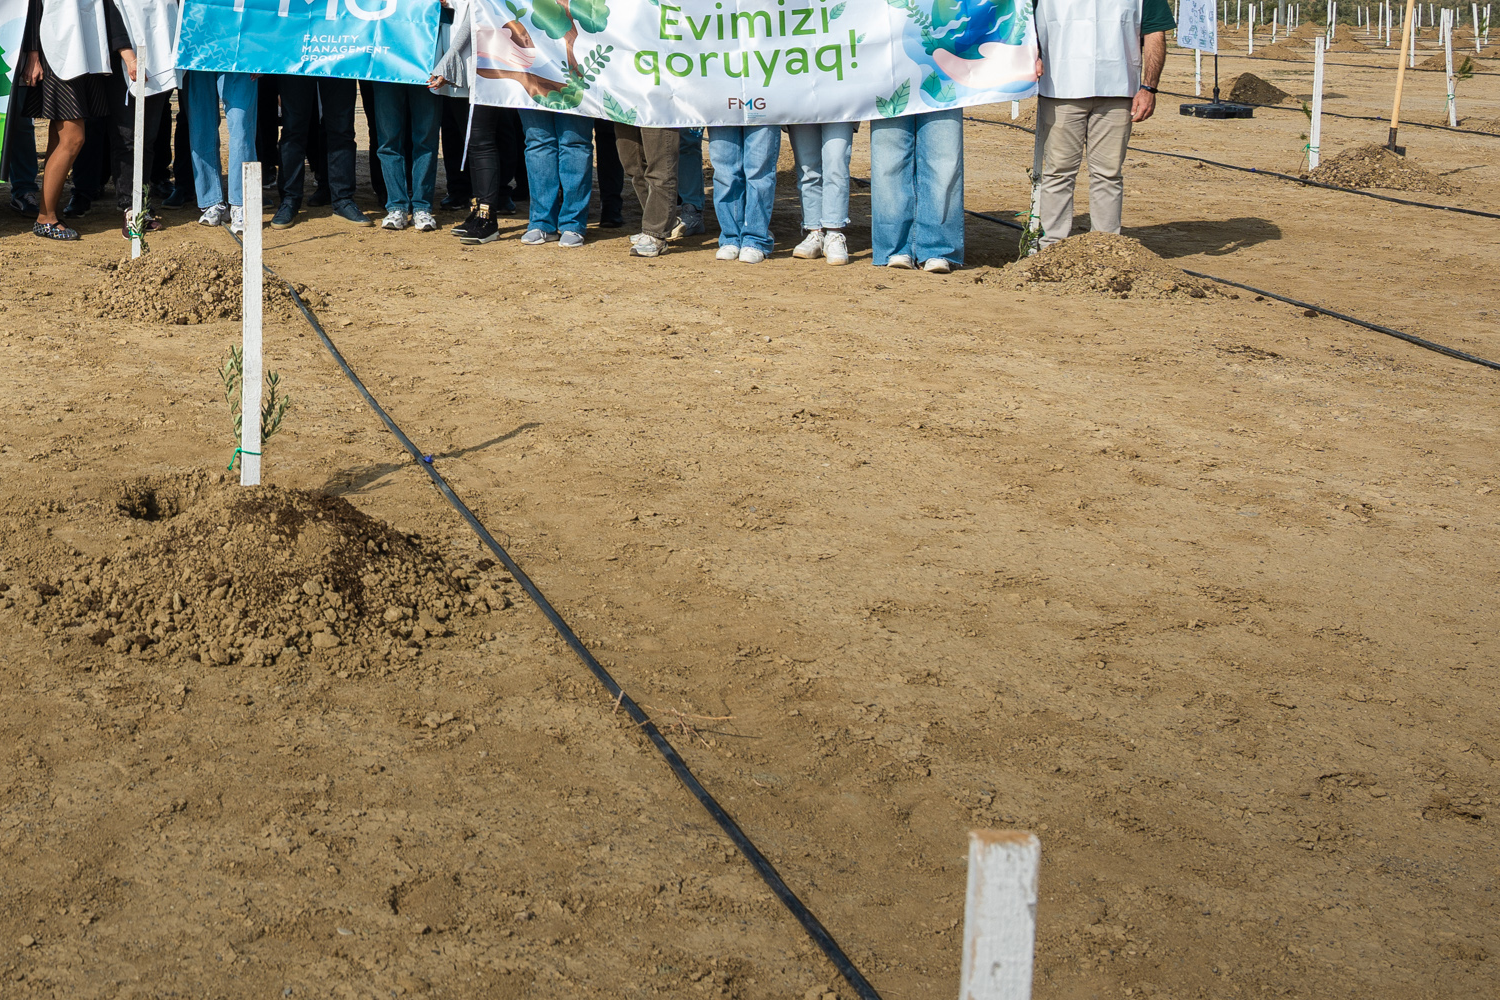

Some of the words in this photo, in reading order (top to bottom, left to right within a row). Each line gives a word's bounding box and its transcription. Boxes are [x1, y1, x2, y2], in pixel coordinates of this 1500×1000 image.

[303, 34, 359, 44] FACILITY
[301, 45, 391, 55] MANAGEMENT
[300, 54, 345, 62] GROUP
[633, 29, 859, 87] qoruyaq!
[728, 97, 767, 110] FMG
